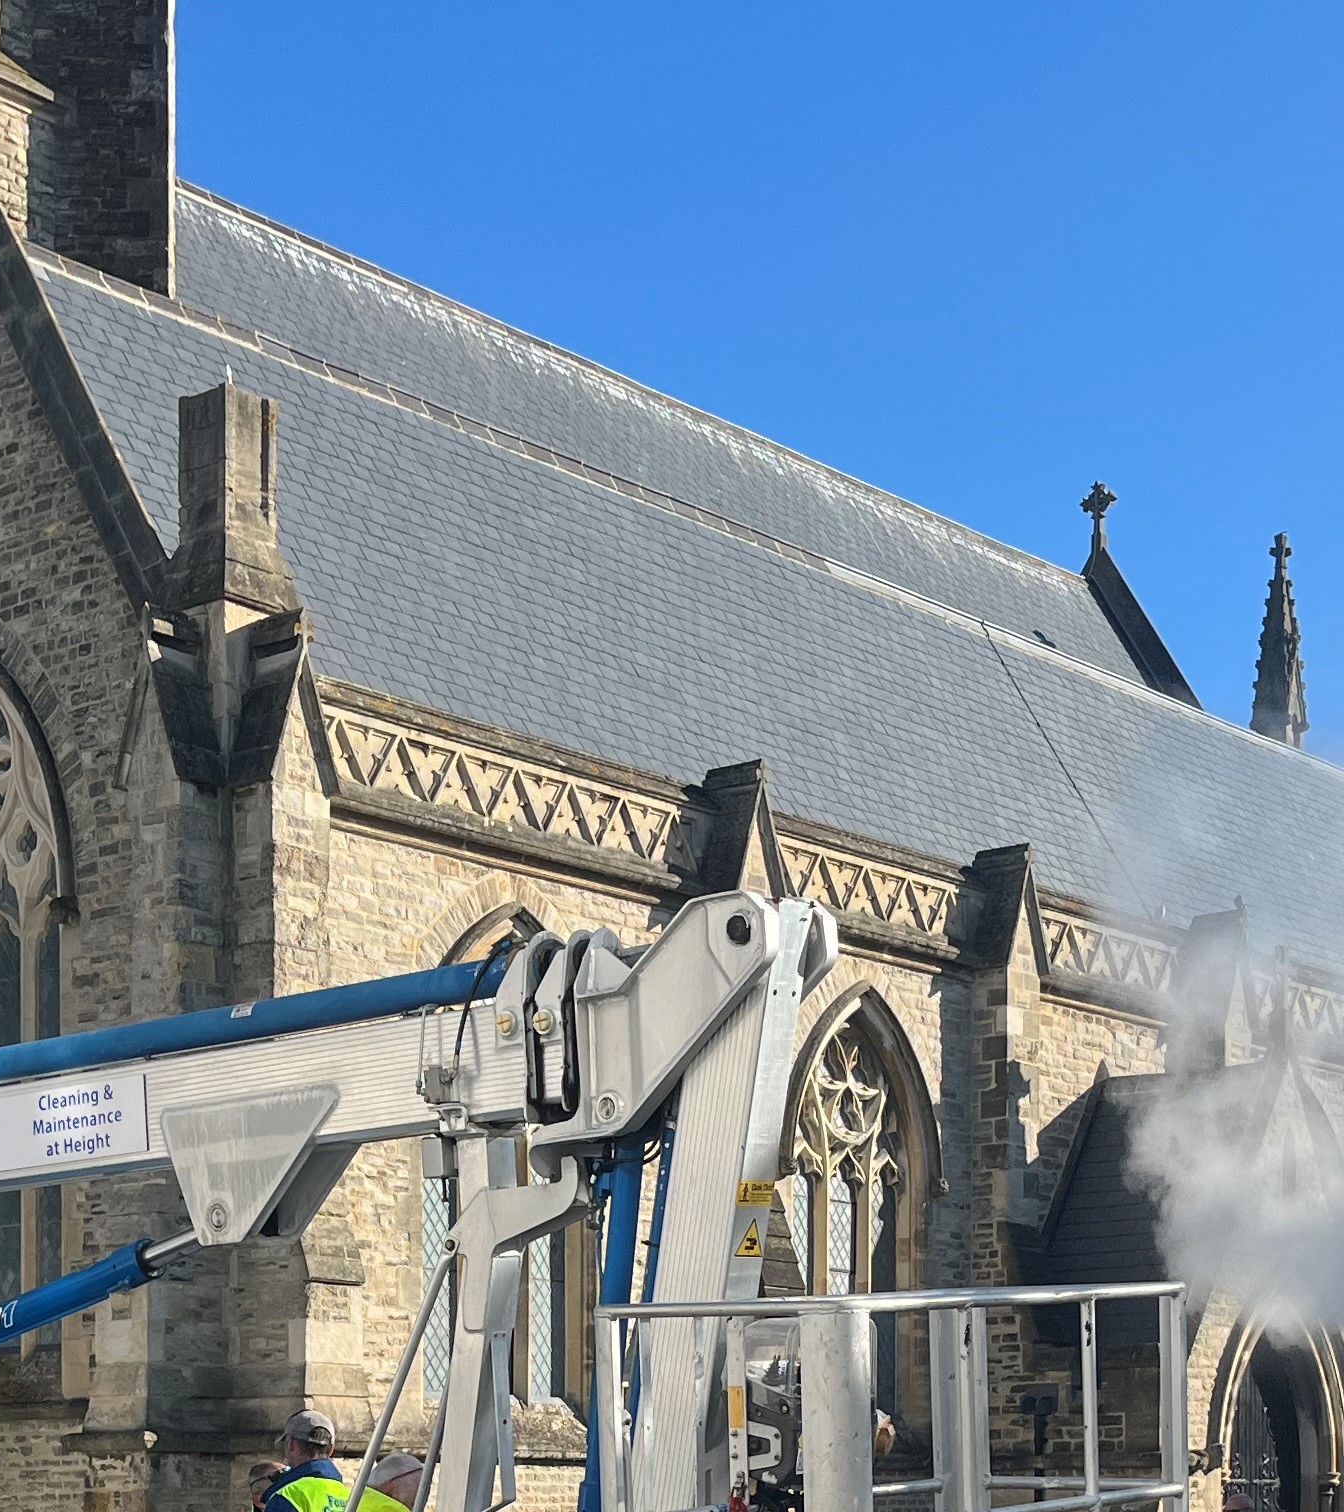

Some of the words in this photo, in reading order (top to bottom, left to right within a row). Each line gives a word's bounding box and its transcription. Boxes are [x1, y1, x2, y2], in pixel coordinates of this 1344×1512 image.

[38, 1090, 99, 1111] Cleaning
[103, 1084, 114, 1100] &
[32, 1110, 123, 1136] Maintenance
[46, 1142, 59, 1157] at
[63, 1135, 111, 1156] Height
